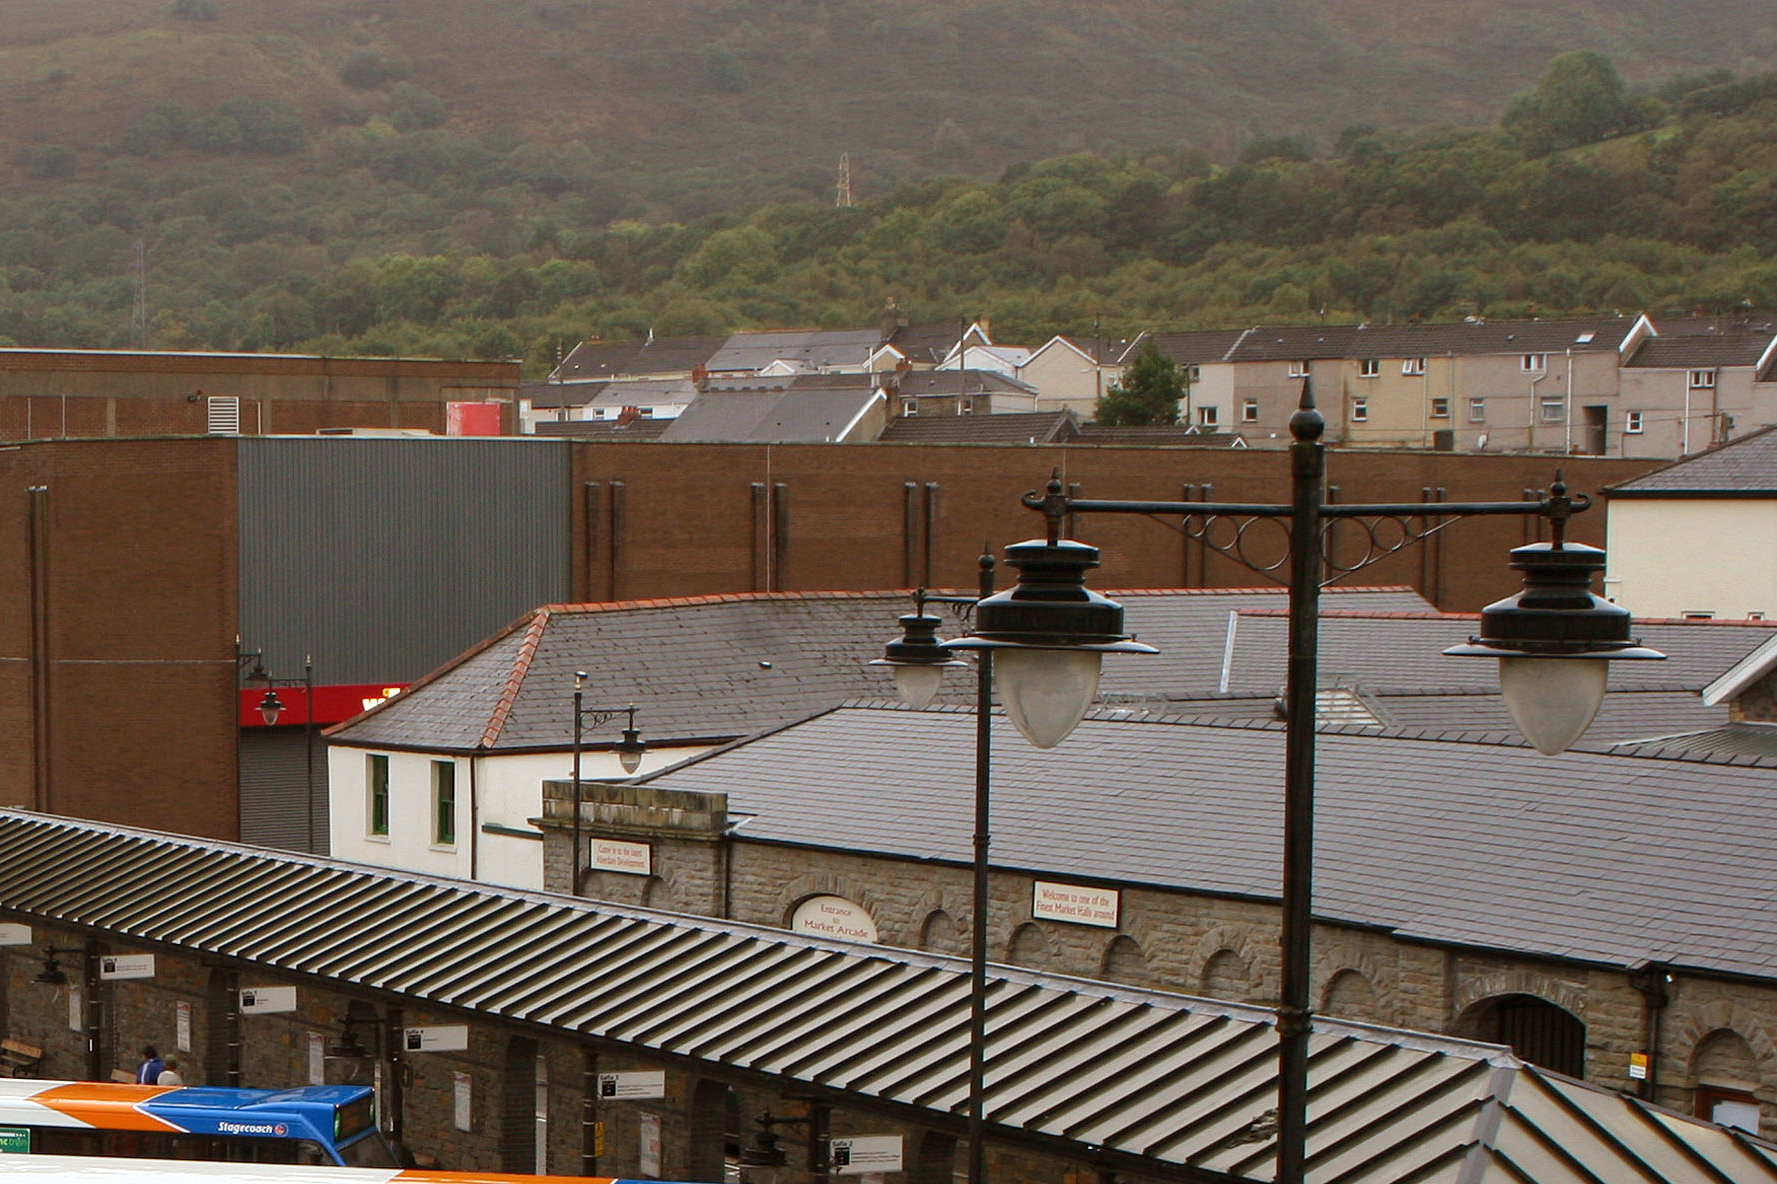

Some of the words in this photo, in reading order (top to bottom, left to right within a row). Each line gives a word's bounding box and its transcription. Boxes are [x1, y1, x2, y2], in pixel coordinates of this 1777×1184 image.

[1041, 888, 1070, 901] Welcome
[1071, 894, 1078, 903] to
[1079, 896, 1090, 904] one
[821, 904, 852, 917] Entrance
[1055, 903, 1076, 915] Market
[804, 919, 834, 933] Market
[837, 926, 869, 938] Arcade
[218, 1121, 273, 1135] Stagecoach
